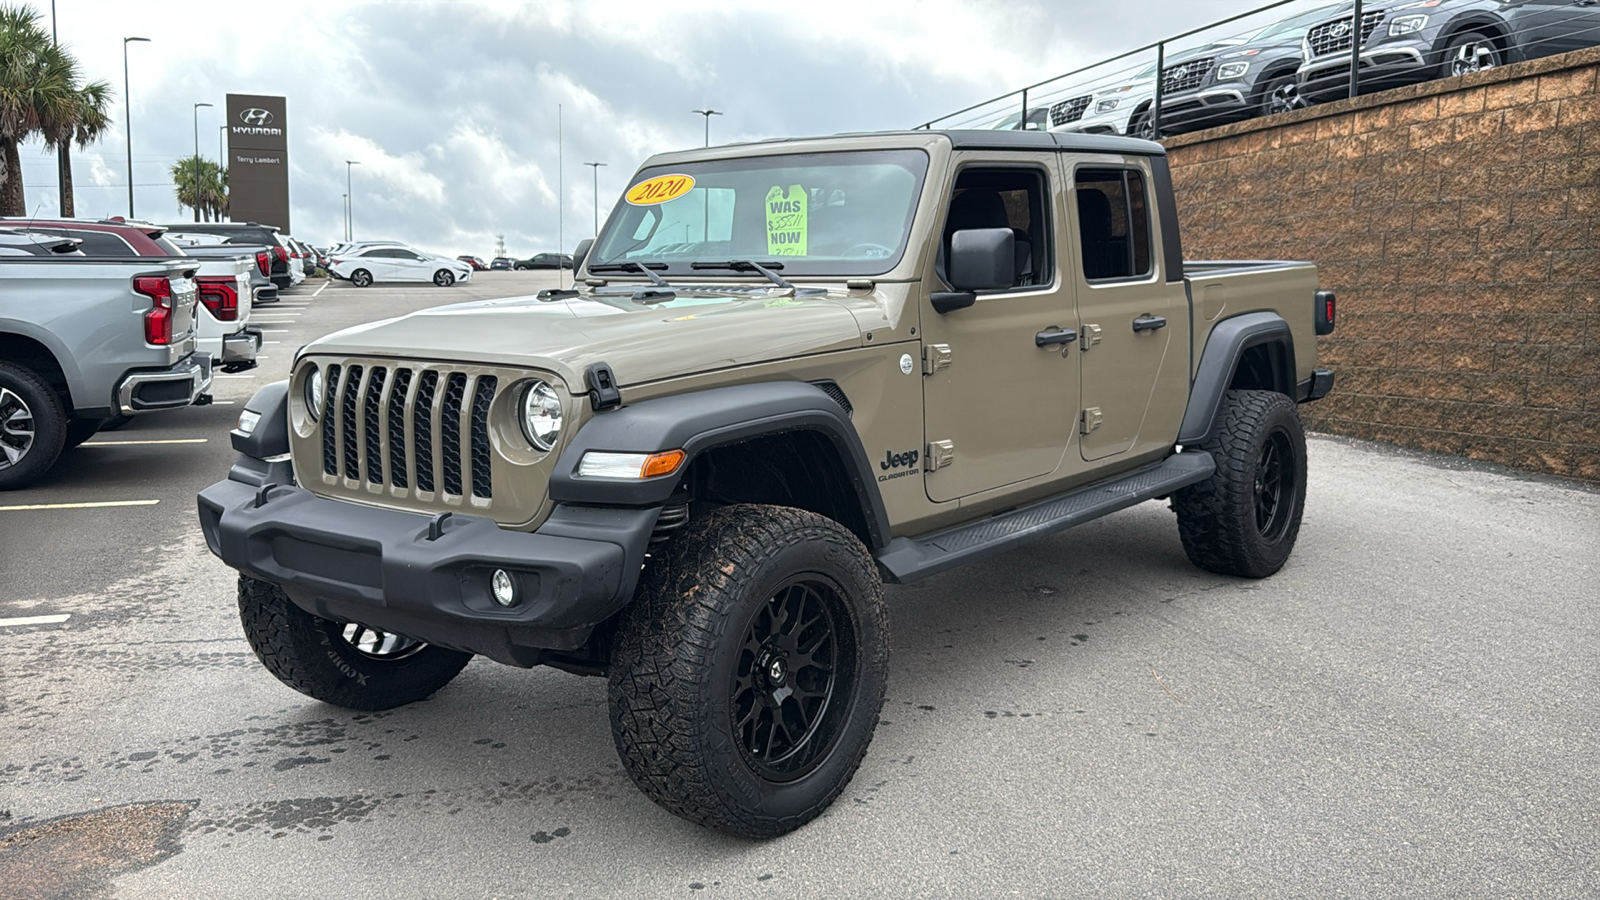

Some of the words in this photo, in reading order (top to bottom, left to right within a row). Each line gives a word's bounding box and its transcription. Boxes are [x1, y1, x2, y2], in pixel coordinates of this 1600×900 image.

[232, 126, 282, 136] HYUNDAI
[236, 155, 254, 164] Terry
[254, 156, 280, 164] Lambert
[633, 178, 686, 201] 2020
[770, 200, 801, 214] WAS
[771, 231, 801, 245] NOW
[880, 449, 919, 470] Jeep
[878, 468, 920, 483] GLADIATOR
